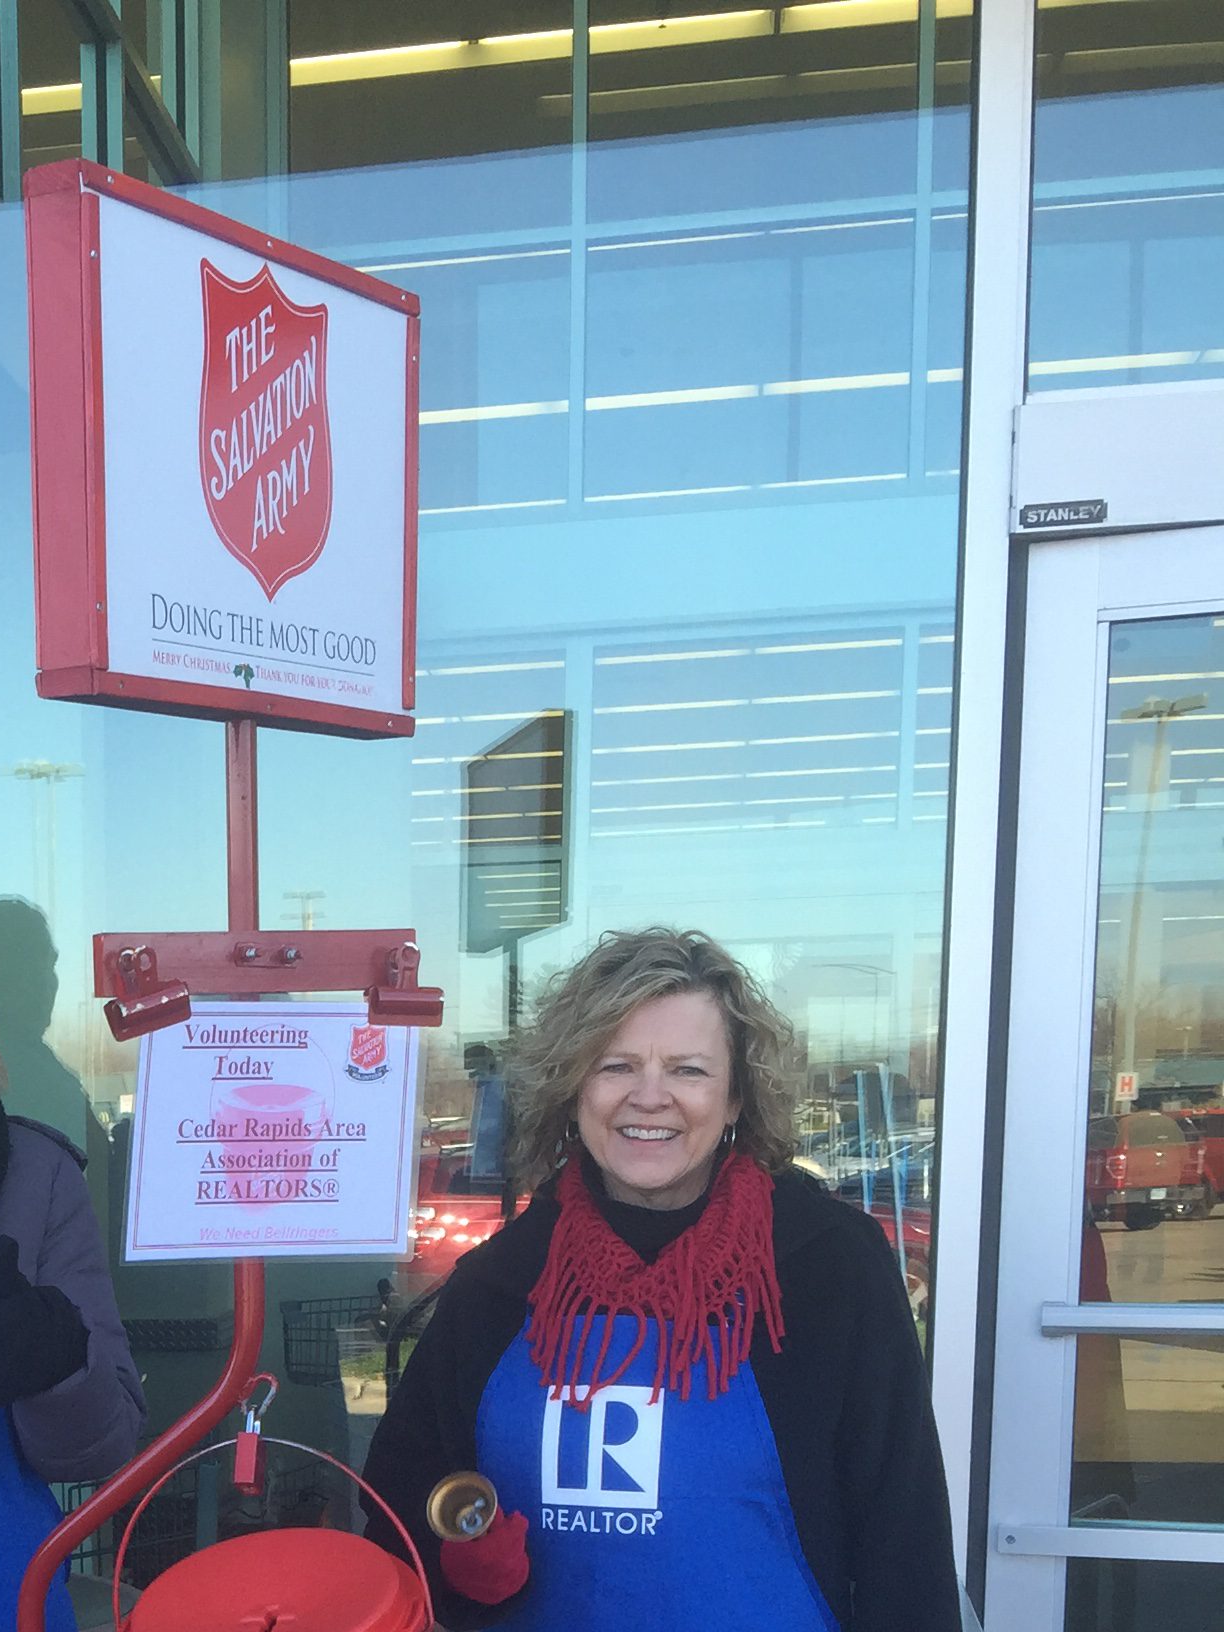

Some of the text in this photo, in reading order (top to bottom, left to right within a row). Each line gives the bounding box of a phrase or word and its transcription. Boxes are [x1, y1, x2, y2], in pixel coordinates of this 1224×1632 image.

[225, 304, 276, 394] THE
[210, 336, 317, 501] SALVATION
[251, 426, 314, 552] ARMY
[1026, 505, 1101, 523] STANLEY
[151, 593, 377, 666] DOING THE MOST GOOD
[152, 649, 181, 666] MERRY
[183, 654, 232, 674] CHRISTMAS
[283, 670, 300, 685] YOU
[301, 673, 317, 688] FOR
[184, 1024, 309, 1046] Volunteering
[214, 1055, 274, 1080] Today
[178, 1117, 366, 1141] Cedar Rapids Area
[201, 1148, 341, 1170] Association of
[200, 1227, 221, 1241] We
[225, 1226, 261, 1241] Need
